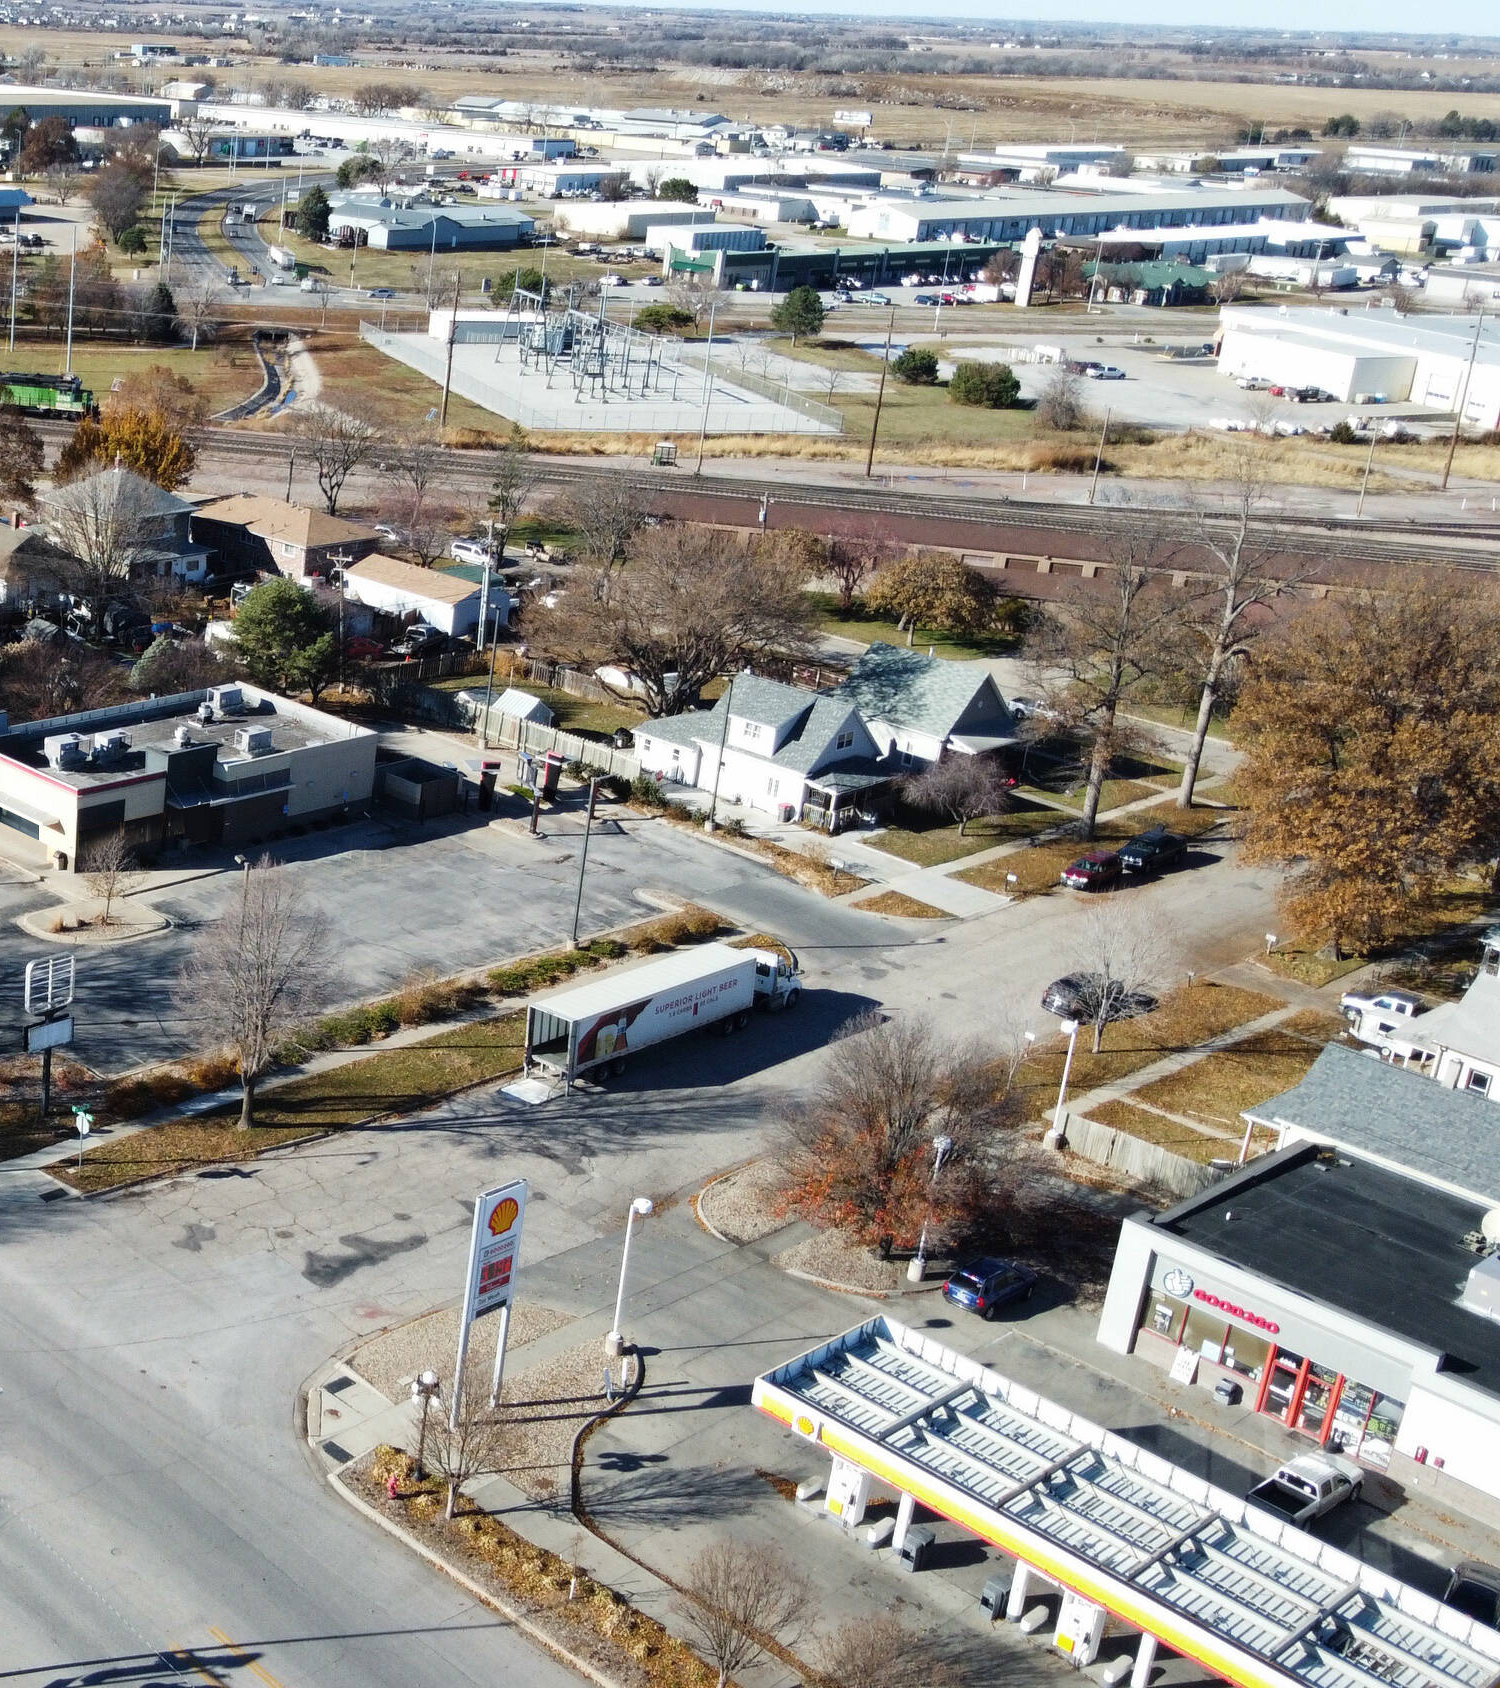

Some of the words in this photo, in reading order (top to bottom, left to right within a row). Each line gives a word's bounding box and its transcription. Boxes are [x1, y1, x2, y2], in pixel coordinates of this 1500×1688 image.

[654, 995, 693, 1015] SUPERIOR
[694, 984, 717, 1000] LIGHT
[718, 978, 738, 992] BEER
[1193, 1288, 1280, 1335] GOOD2GO
